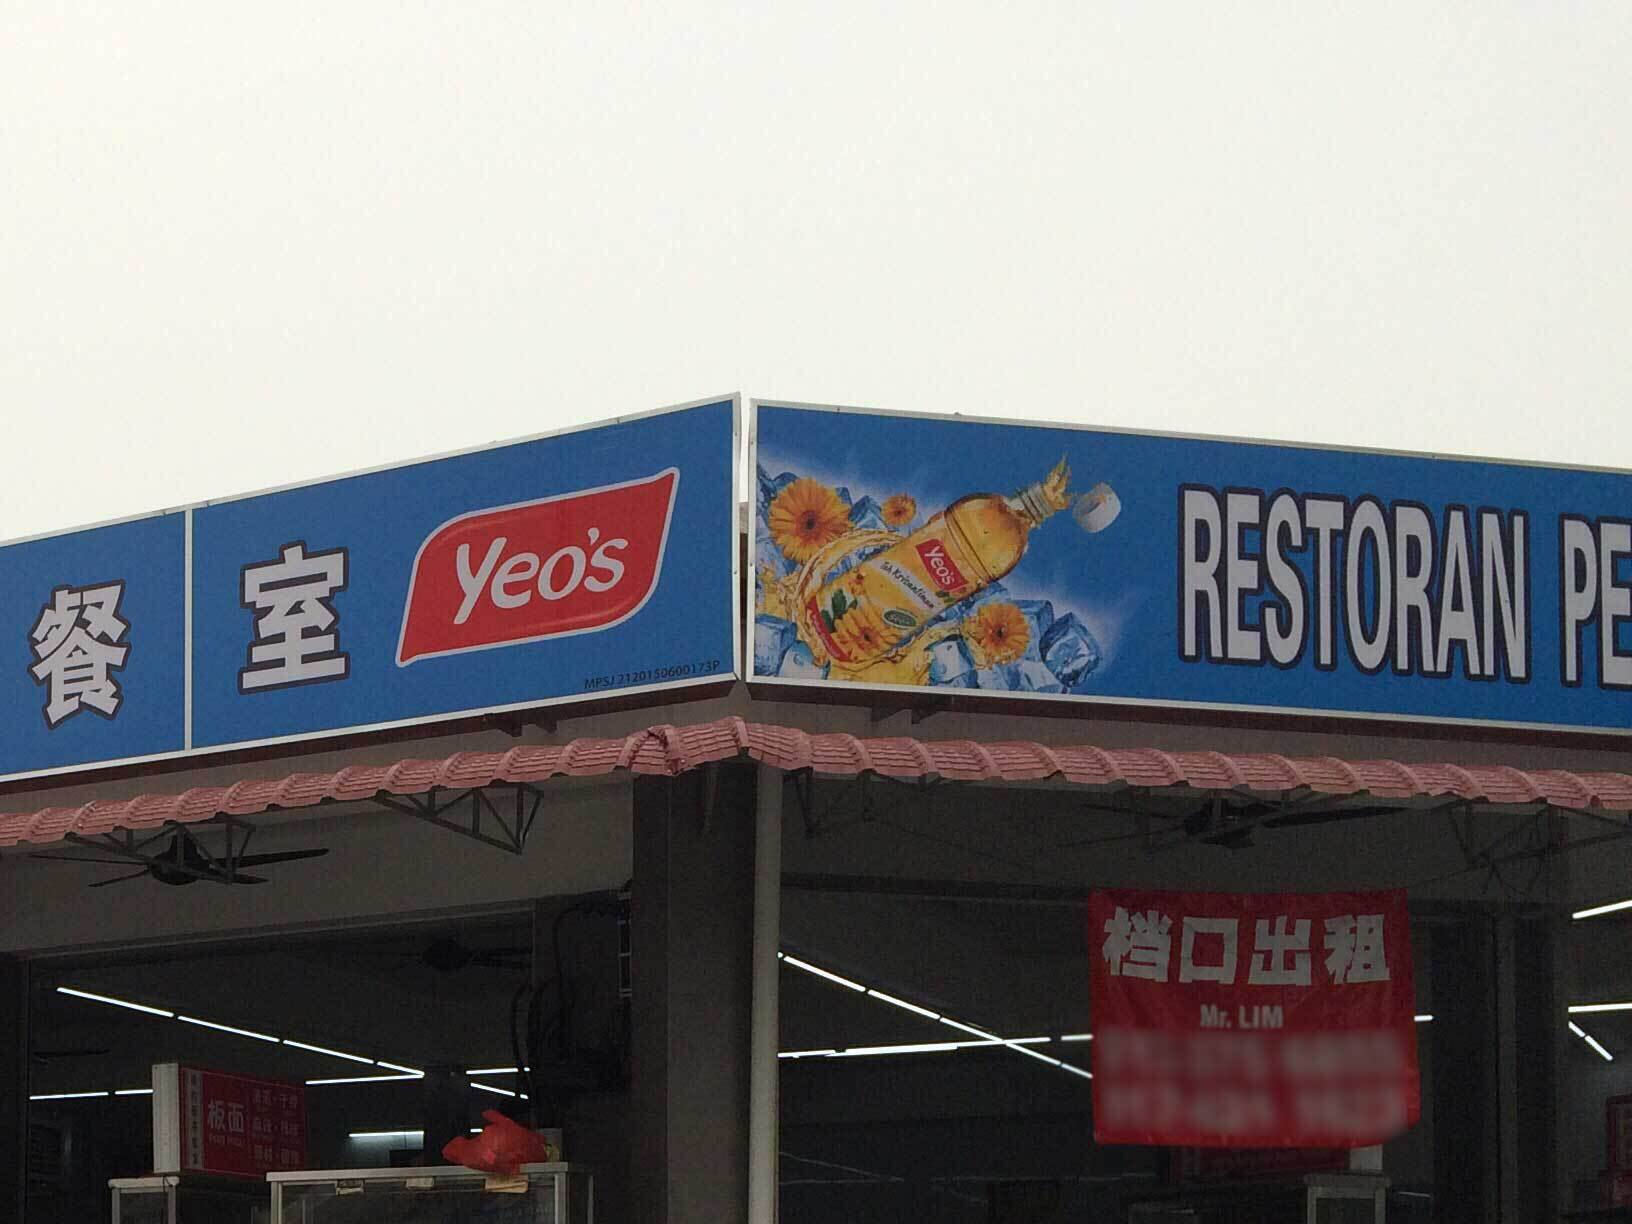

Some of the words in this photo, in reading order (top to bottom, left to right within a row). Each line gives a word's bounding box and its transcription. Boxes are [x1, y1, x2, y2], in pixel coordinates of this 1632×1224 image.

[454, 526, 629, 626] Yeo's
[924, 544, 956, 587] Yeo's
[1180, 486, 1529, 681] RESTORAN
[1562, 517, 1632, 688] PE
[584, 674, 615, 690] MPSJ
[1102, 906, 1392, 987] 档口出租
[1200, 1004, 1232, 1029] Mr.
[1238, 1004, 1284, 1030] LIM
